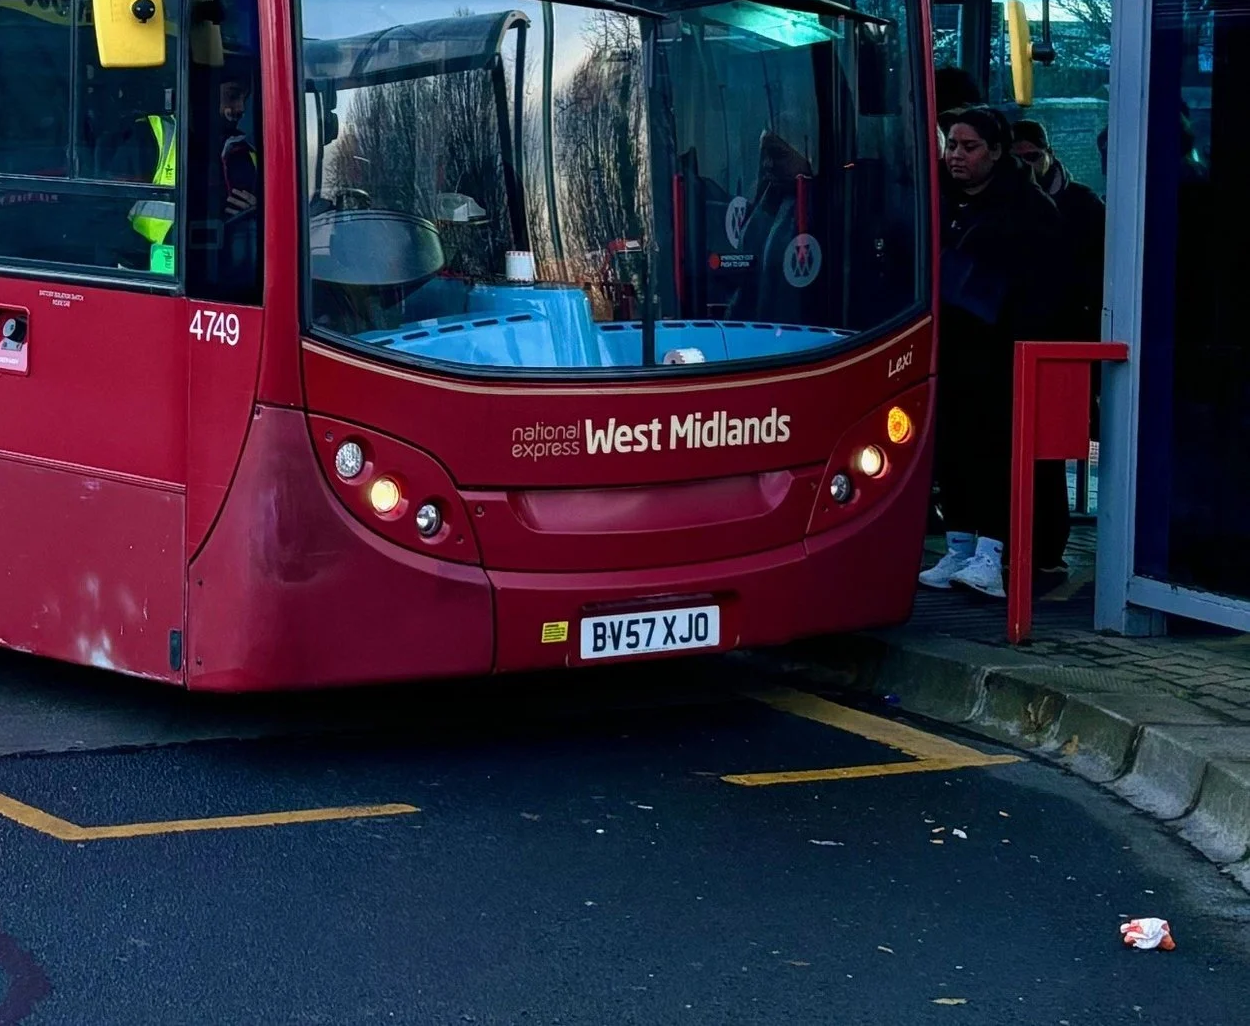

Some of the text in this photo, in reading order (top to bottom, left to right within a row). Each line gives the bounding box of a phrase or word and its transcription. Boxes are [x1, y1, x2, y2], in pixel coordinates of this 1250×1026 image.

[189, 309, 240, 346] 4749
[888, 344, 914, 378] Lexi
[511, 419, 581, 442] national
[584, 407, 791, 455] West Midlands
[511, 440, 581, 462] express
[592, 617, 656, 653] BV57
[662, 612, 709, 646] XJO
